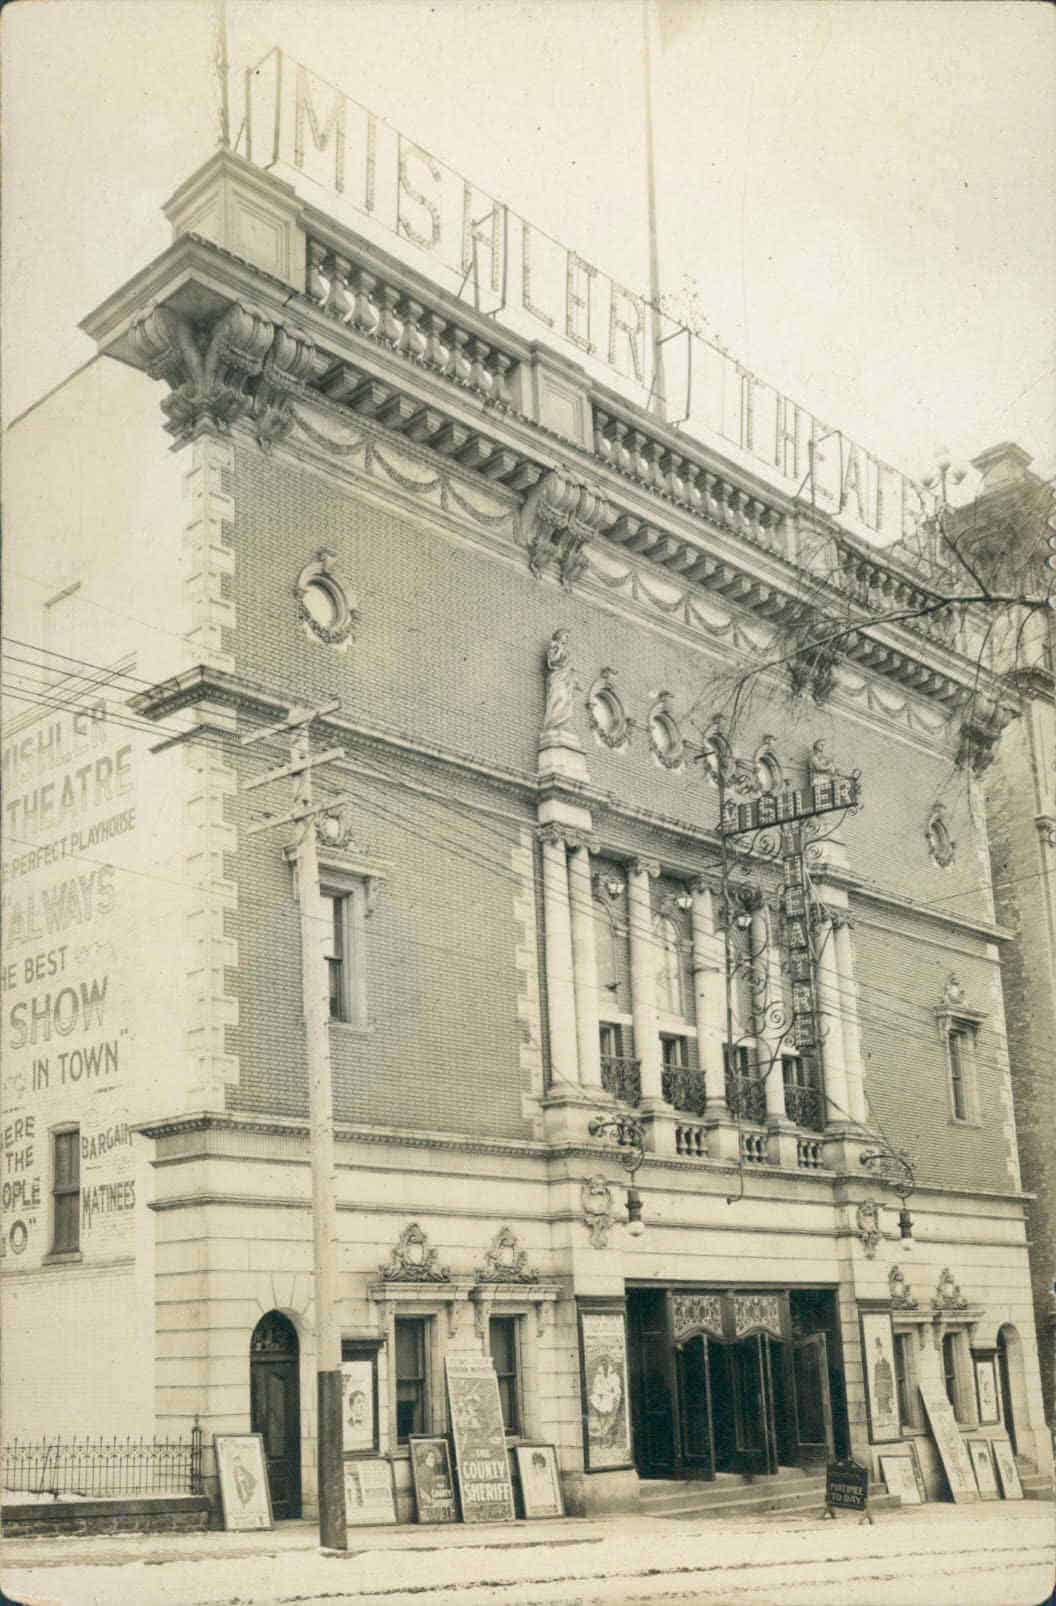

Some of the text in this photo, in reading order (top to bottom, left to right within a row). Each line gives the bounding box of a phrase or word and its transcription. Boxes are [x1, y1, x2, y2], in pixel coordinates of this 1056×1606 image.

[294, 62, 648, 386] MISHLER
[7, 744, 134, 832] THEATRE
[722, 778, 853, 832] MISHLER
[12, 836, 67, 878] PERFECT
[71, 807, 137, 854] PLAYHOUSE
[24, 945, 68, 984] BEST
[9, 976, 108, 1050] SHOW
[32, 1057, 49, 1092] IN
[5, 1145, 34, 1174] THE
[81, 1122, 133, 1160] BARGAIN
[81, 1180, 136, 1216] MATINEES
[463, 1460, 506, 1481] COUNTY
[463, 1482, 511, 1504] SHERIFF
